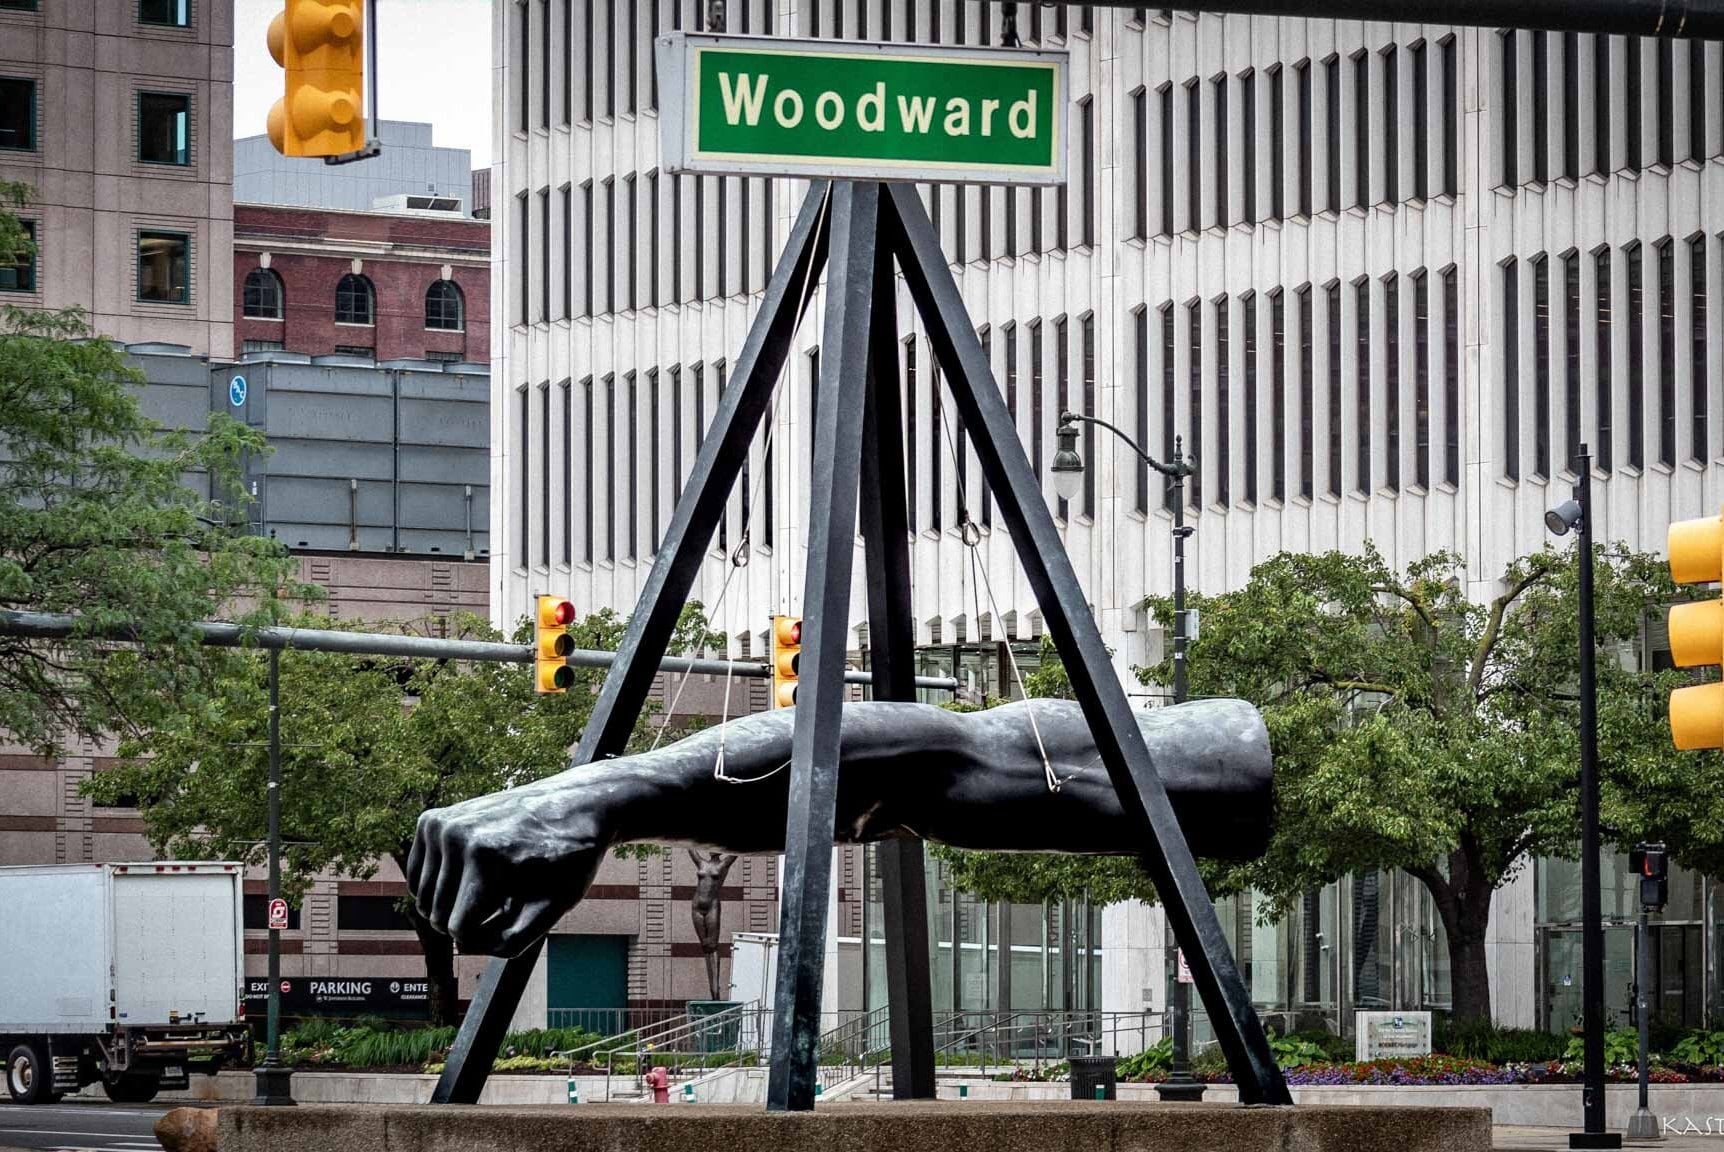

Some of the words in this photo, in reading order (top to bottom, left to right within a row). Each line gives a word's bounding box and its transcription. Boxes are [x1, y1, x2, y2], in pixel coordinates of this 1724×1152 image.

[718, 72, 1037, 139] Woodward
[251, 982, 270, 992] EXI
[310, 982, 372, 994] PARKING
[404, 983, 428, 992] ENTE
